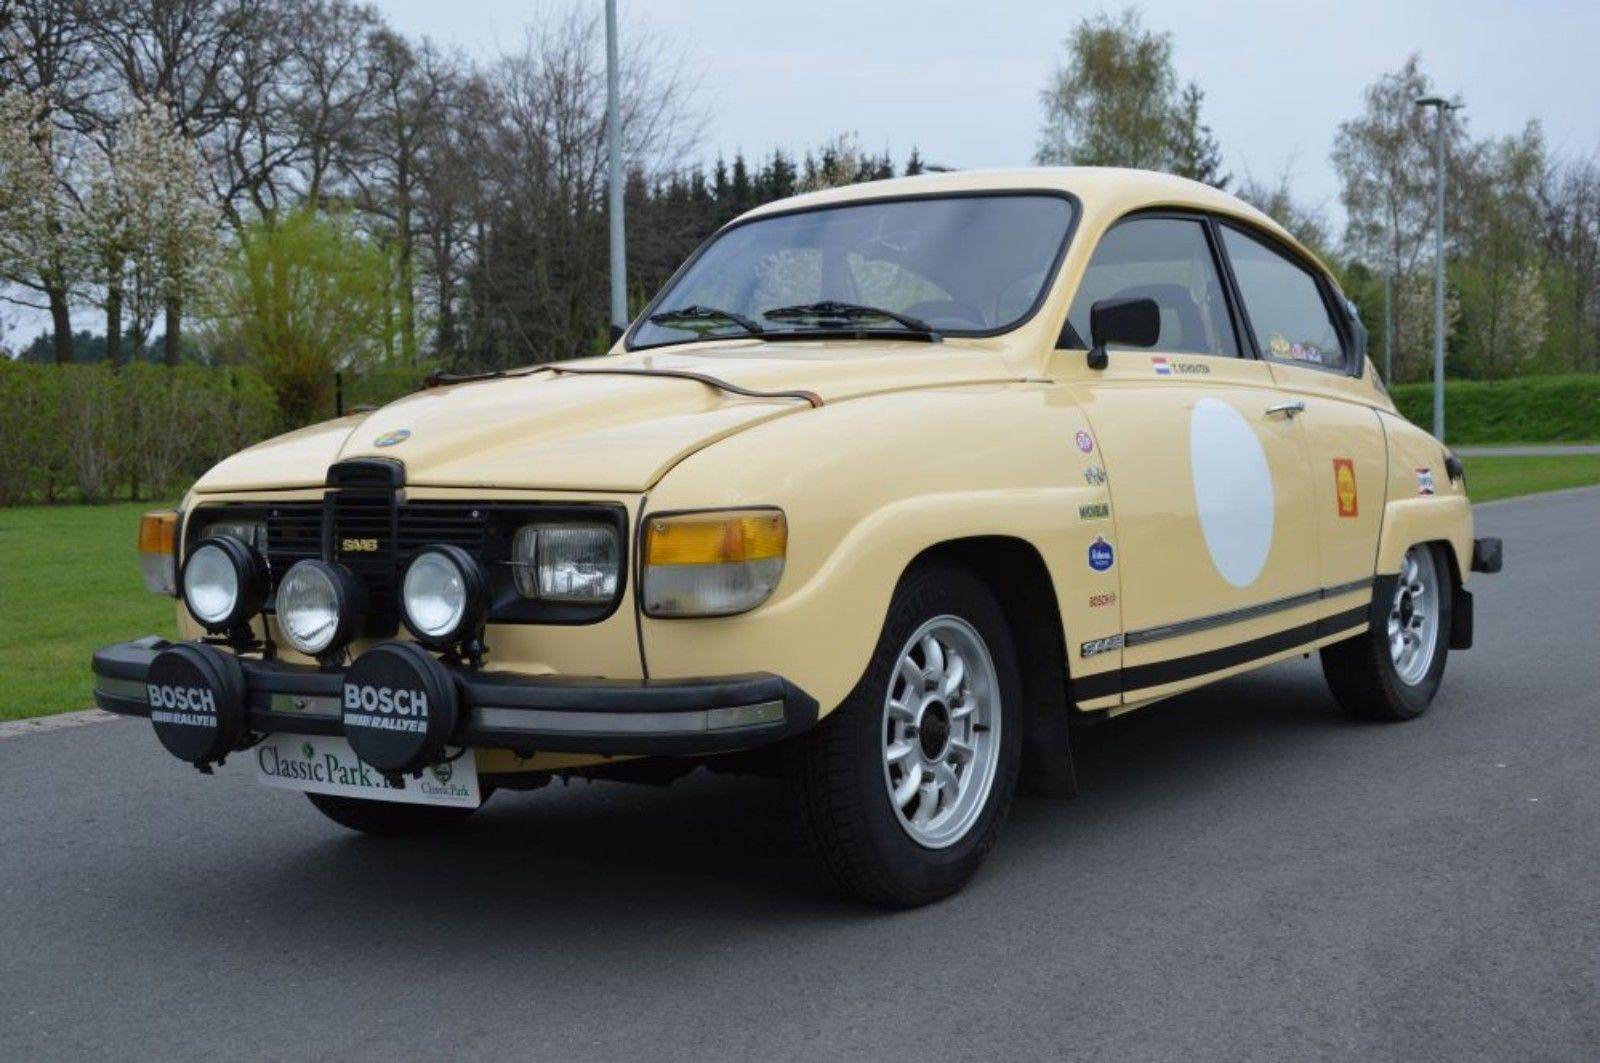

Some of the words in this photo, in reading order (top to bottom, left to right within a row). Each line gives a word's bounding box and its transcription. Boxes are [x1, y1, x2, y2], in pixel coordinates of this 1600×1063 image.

[342, 539, 378, 552] SAAB
[146, 684, 217, 712] BOSCH
[343, 683, 429, 717] BOSCH
[174, 713, 210, 727] RALLYE
[371, 715, 419, 733] RALLYE
